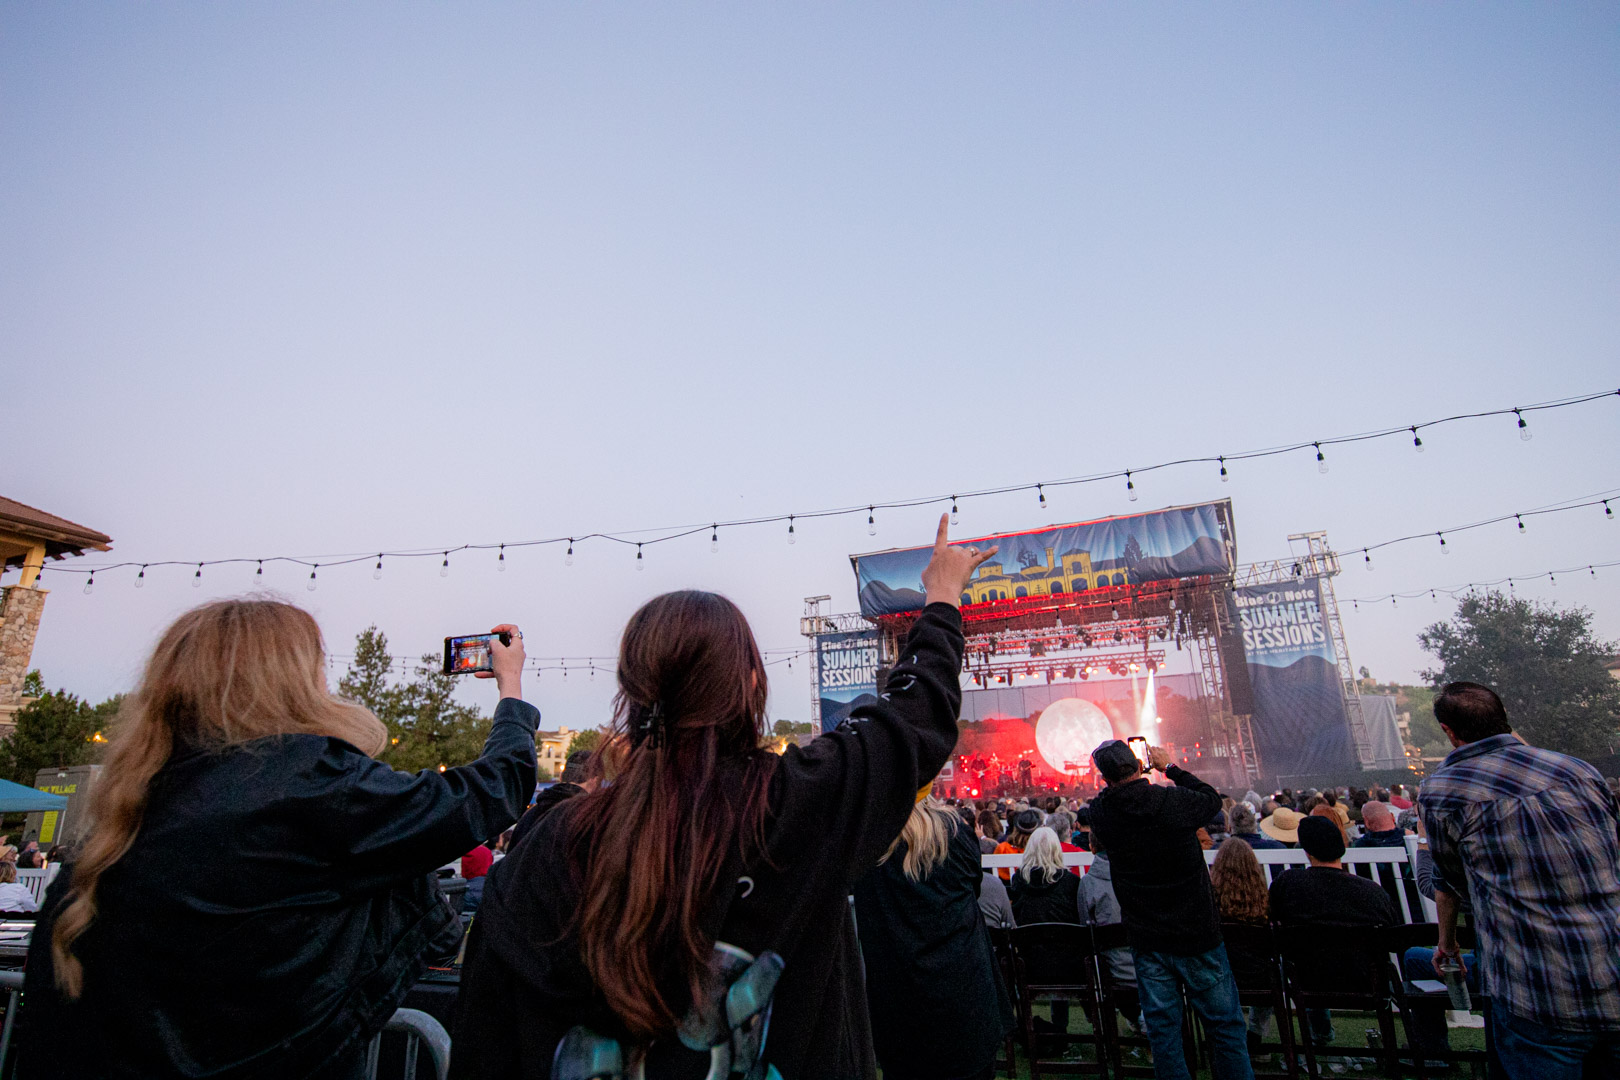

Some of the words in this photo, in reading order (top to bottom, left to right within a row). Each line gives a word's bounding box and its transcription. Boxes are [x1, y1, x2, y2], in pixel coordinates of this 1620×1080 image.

[1284, 589, 1316, 602] Note
[1239, 601, 1322, 630] SUMMER
[1242, 622, 1326, 650] SESSIONS
[822, 648, 879, 670] SUMMER
[822, 666, 878, 687] SESSIONS
[51, 784, 77, 794] VILLAGE
